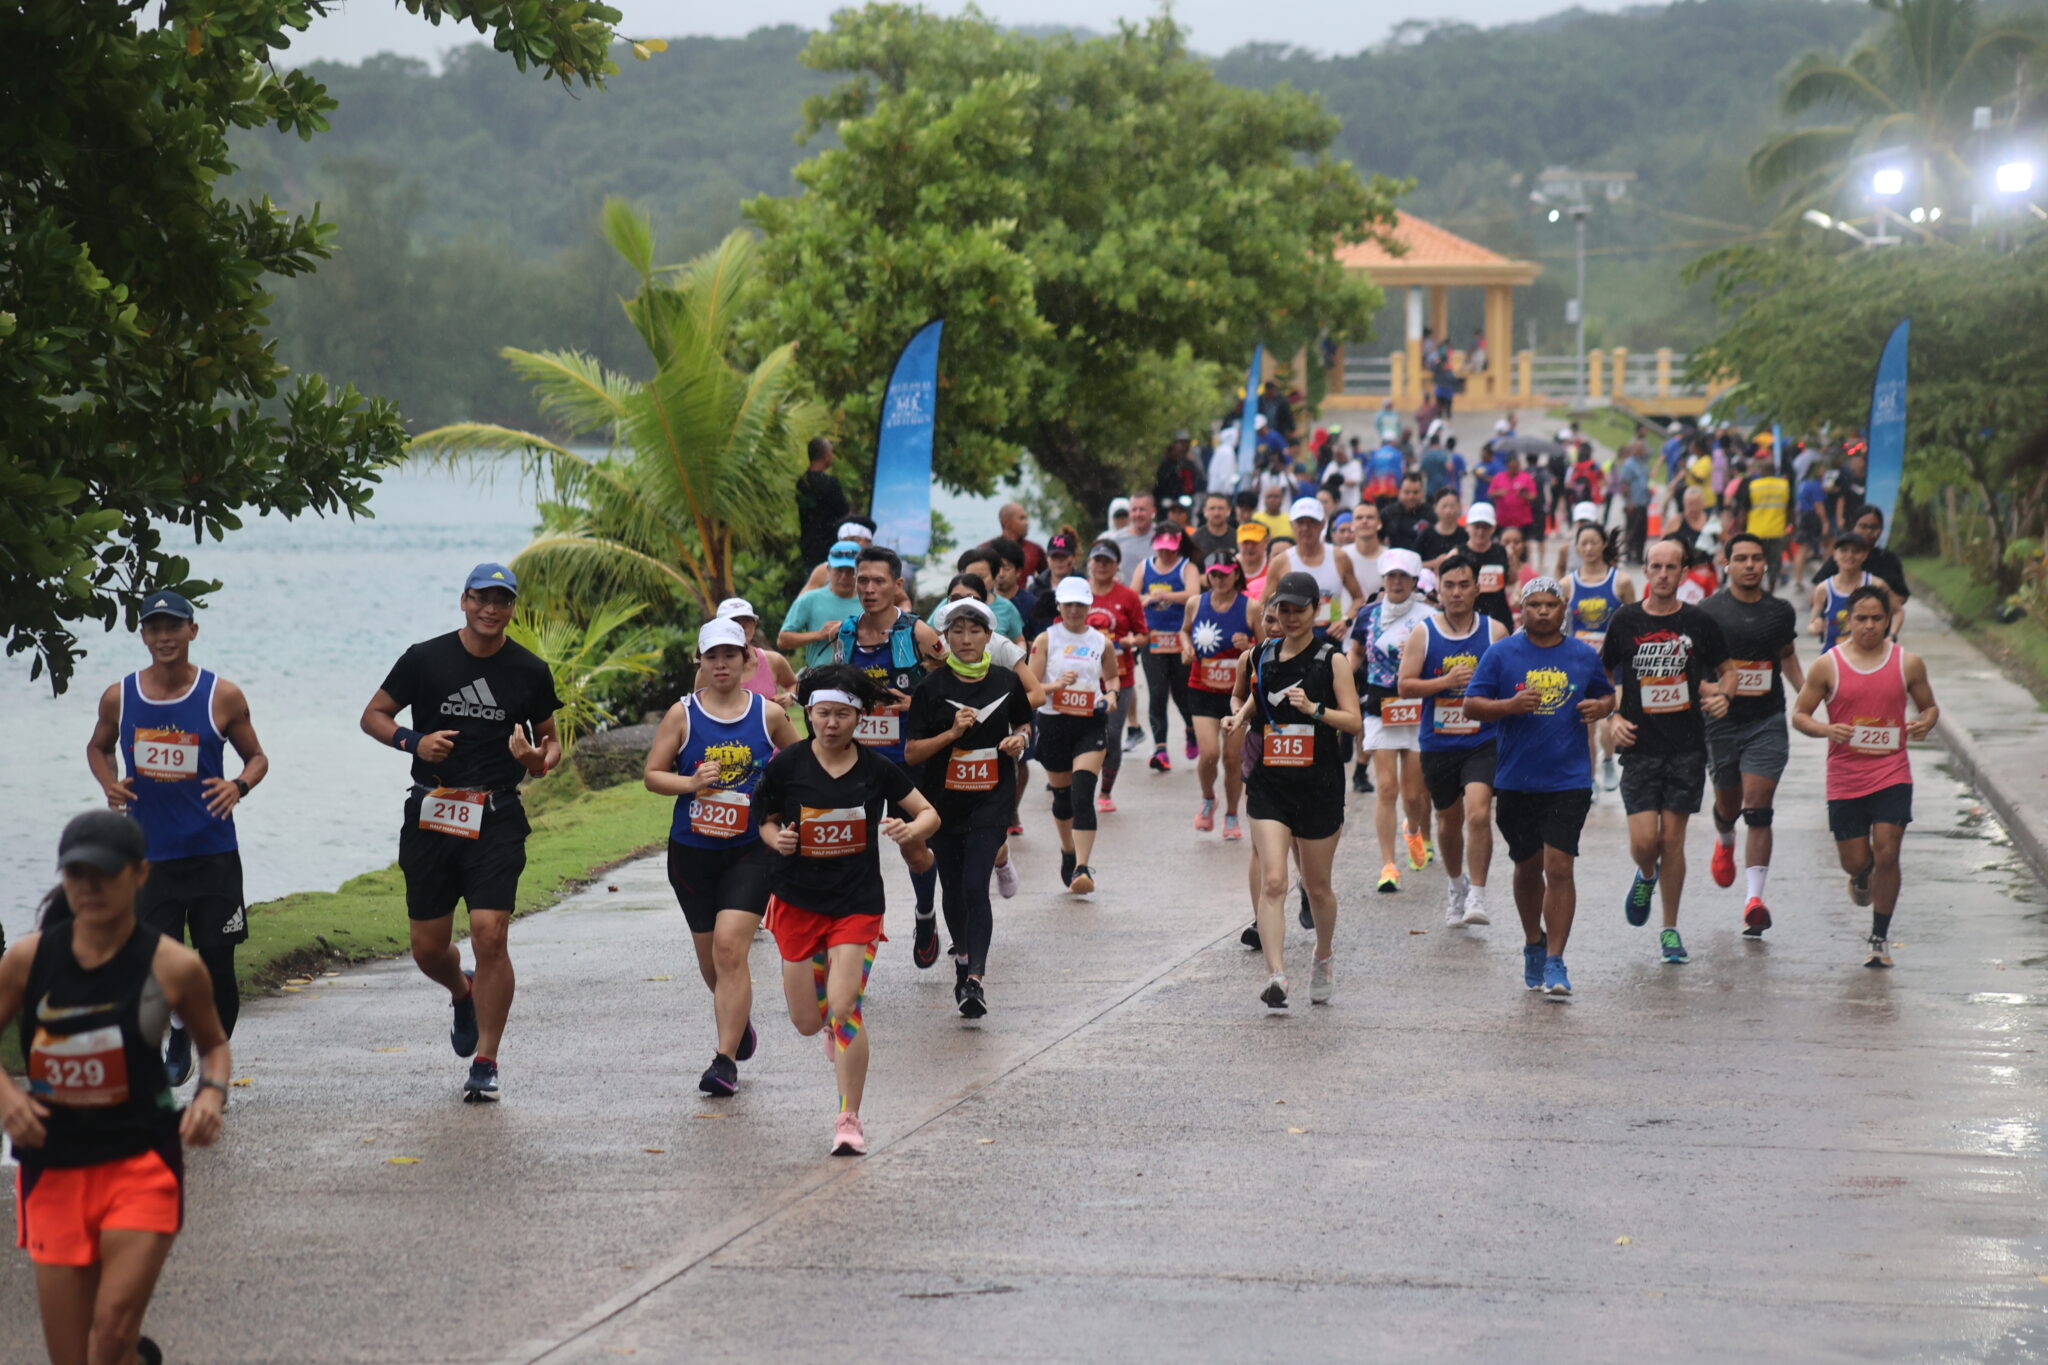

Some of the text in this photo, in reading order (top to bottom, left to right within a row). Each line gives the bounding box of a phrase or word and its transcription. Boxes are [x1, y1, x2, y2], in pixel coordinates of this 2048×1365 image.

[1639, 643, 1668, 656] HOT
[1632, 656, 1687, 669] WHEELS
[1207, 667, 1231, 681] 305
[1061, 691, 1088, 707] 306
[1650, 687, 1681, 703] 224
[440, 700, 506, 721] adidas
[1389, 706, 1418, 722] 334
[860, 719, 889, 735] 215
[1860, 729, 1891, 745] 226
[1272, 738, 1304, 755] 315
[146, 746, 185, 767] 219
[956, 763, 989, 780] 314
[433, 802, 470, 823] 218
[703, 804, 738, 826] 320
[442, 826, 470, 837] MARATHON
[813, 824, 854, 844] 324
[825, 847, 856, 855] MARATHON
[44, 1058, 105, 1088] 329
